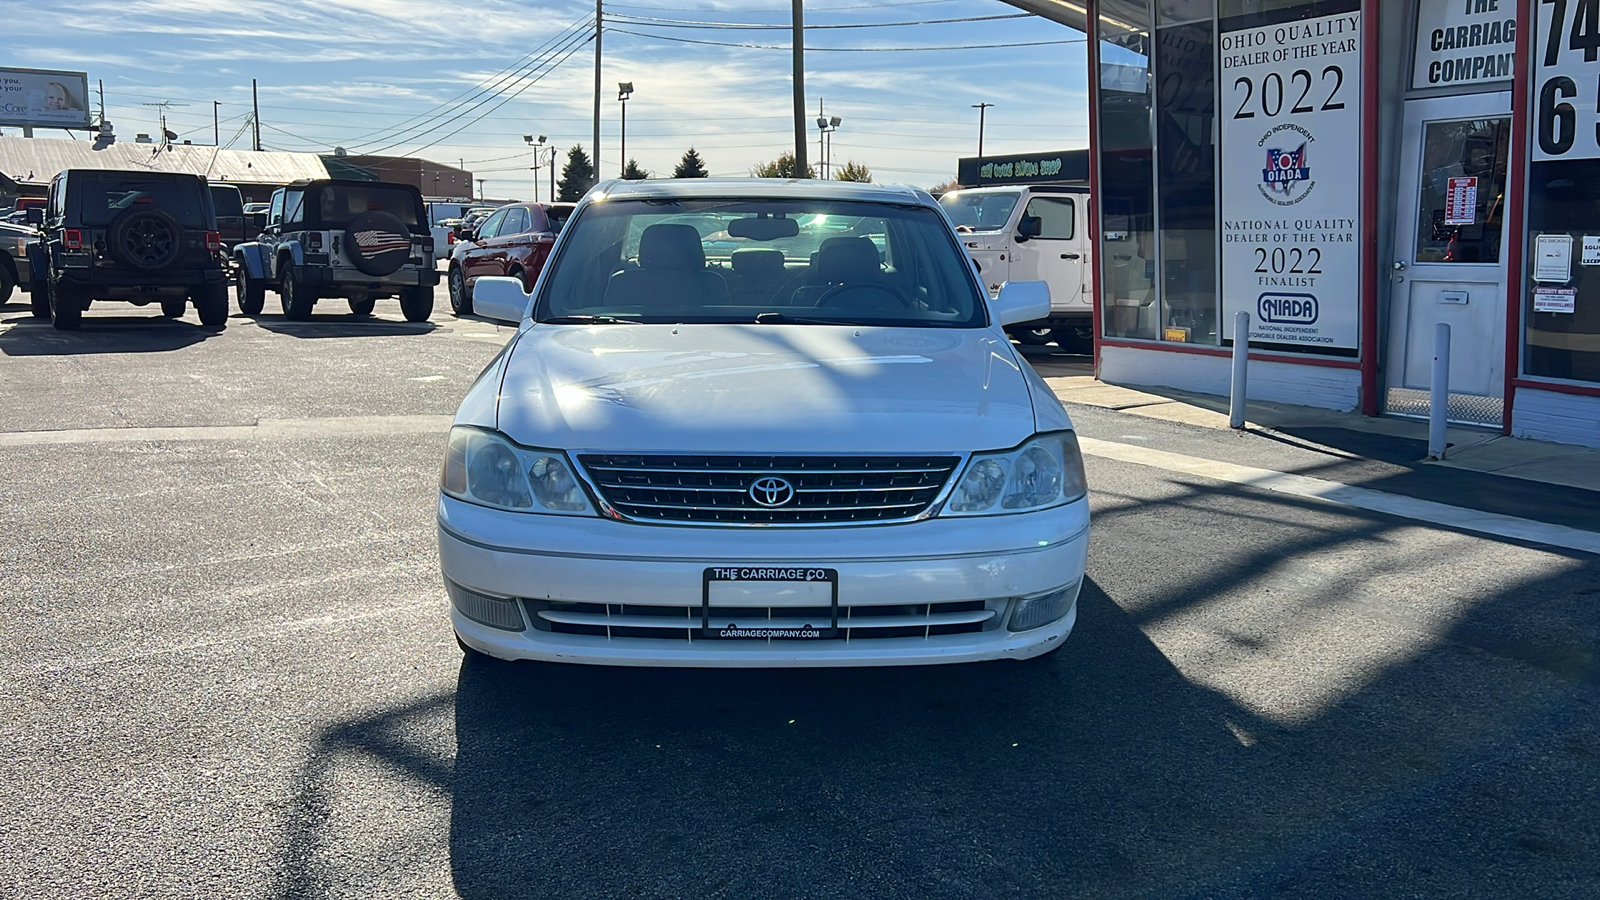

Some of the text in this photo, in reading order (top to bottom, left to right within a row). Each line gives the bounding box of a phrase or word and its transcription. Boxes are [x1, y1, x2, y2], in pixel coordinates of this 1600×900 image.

[1222, 16, 1360, 51] OHIO QUALITY
[1430, 19, 1516, 52] CARRIAG
[1224, 51, 1270, 69] DEALER
[1272, 48, 1289, 62] OF
[1292, 44, 1318, 60] THE
[1321, 38, 1357, 55] YEAR
[1233, 65, 1345, 119] 2022
[1257, 123, 1316, 147] OHIO INDEPENDENT
[1040, 157, 1062, 176] SHOP
[1268, 169, 1302, 181] OIADA
[1225, 219, 1355, 231] NATIONAL QUALITY
[1226, 233, 1353, 242] DEALER OF THE YEAR
[1254, 247, 1322, 274] 2022
[1258, 276, 1316, 287] FINALIST
[1262, 299, 1313, 317] NIADA
[1276, 333, 1297, 341] DEALERS
[1298, 335, 1334, 344] ASSOCIATION
[714, 569, 828, 579] THE CARRIAGE CO.
[720, 630, 820, 638] CARRIAGECOMPANY.COM
